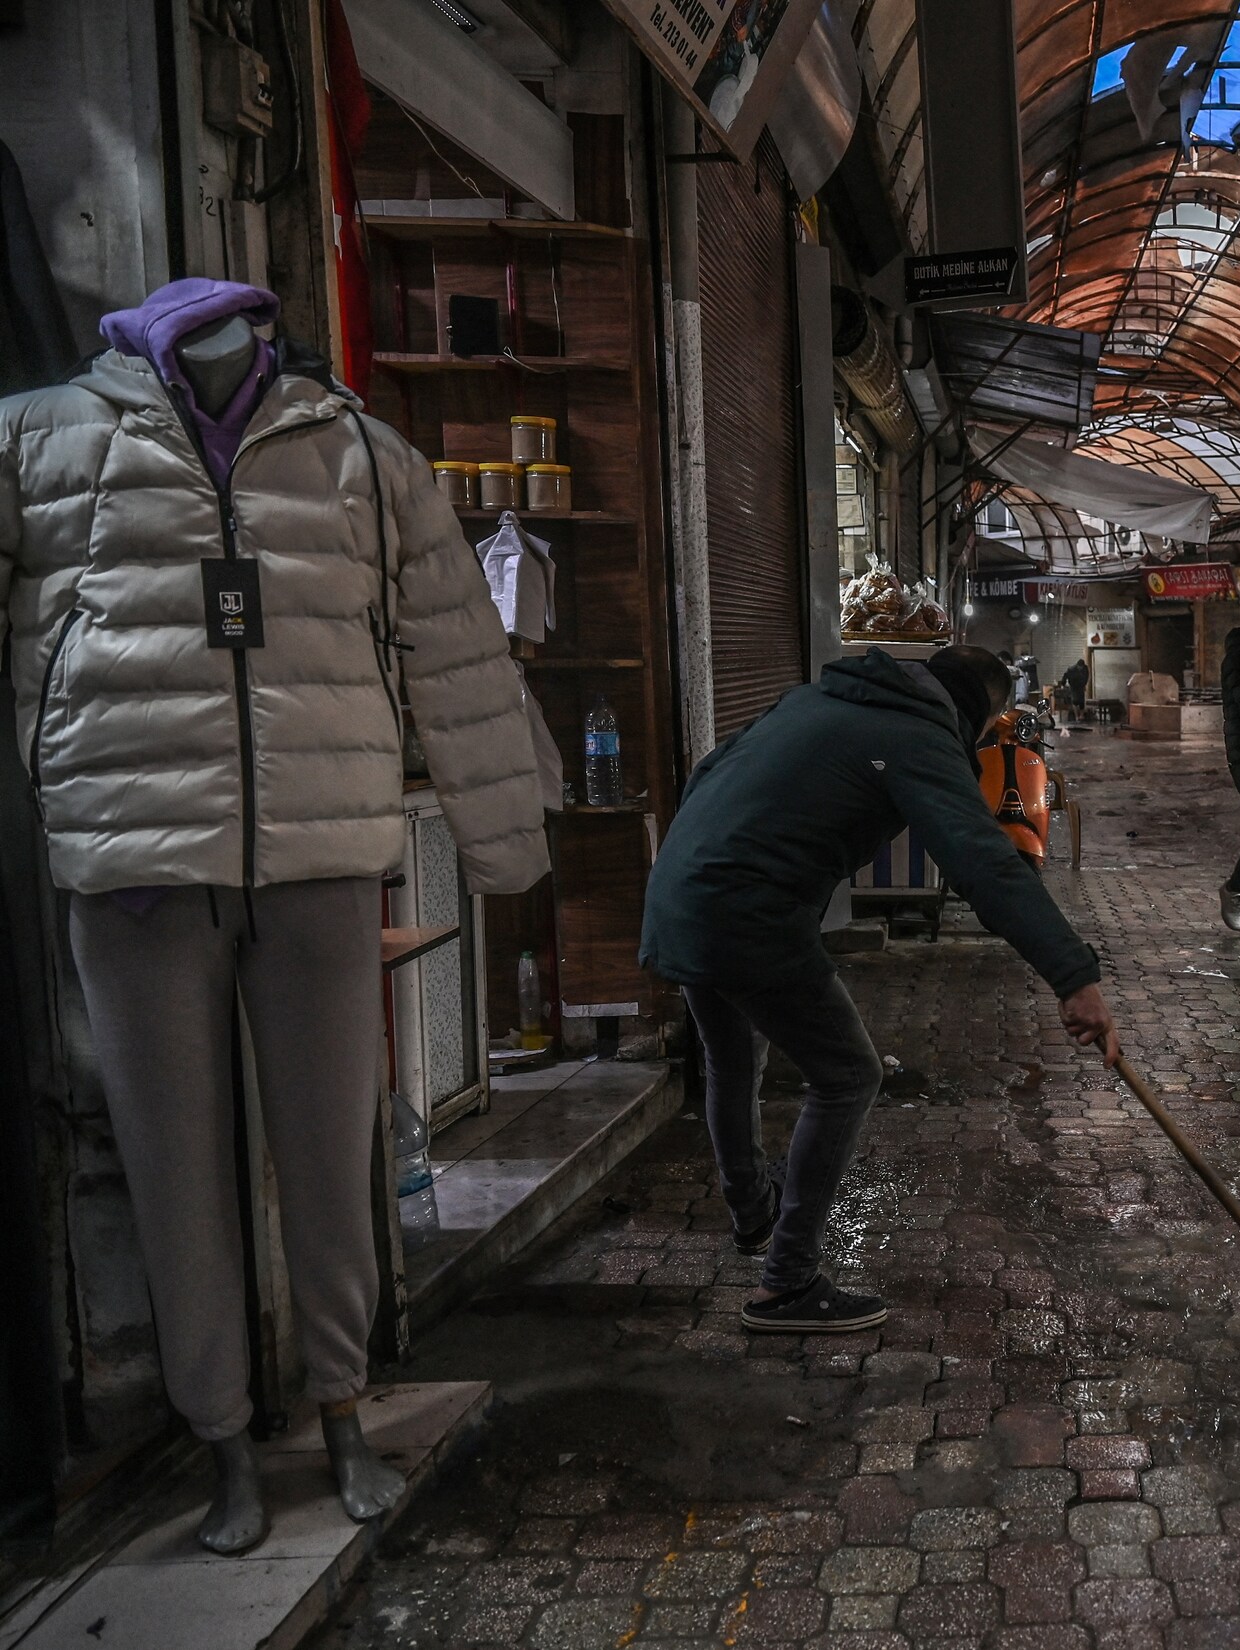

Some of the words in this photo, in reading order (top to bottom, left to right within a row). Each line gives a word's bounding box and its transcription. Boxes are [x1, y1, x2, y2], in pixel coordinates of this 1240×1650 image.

[650, 3, 667, 32] Tel.
[662, 21, 681, 48] 213
[676, 38, 689, 59] 01
[685, 50, 698, 70] 44
[981, 581, 988, 597] &
[989, 577, 1018, 596] KÖMBE
